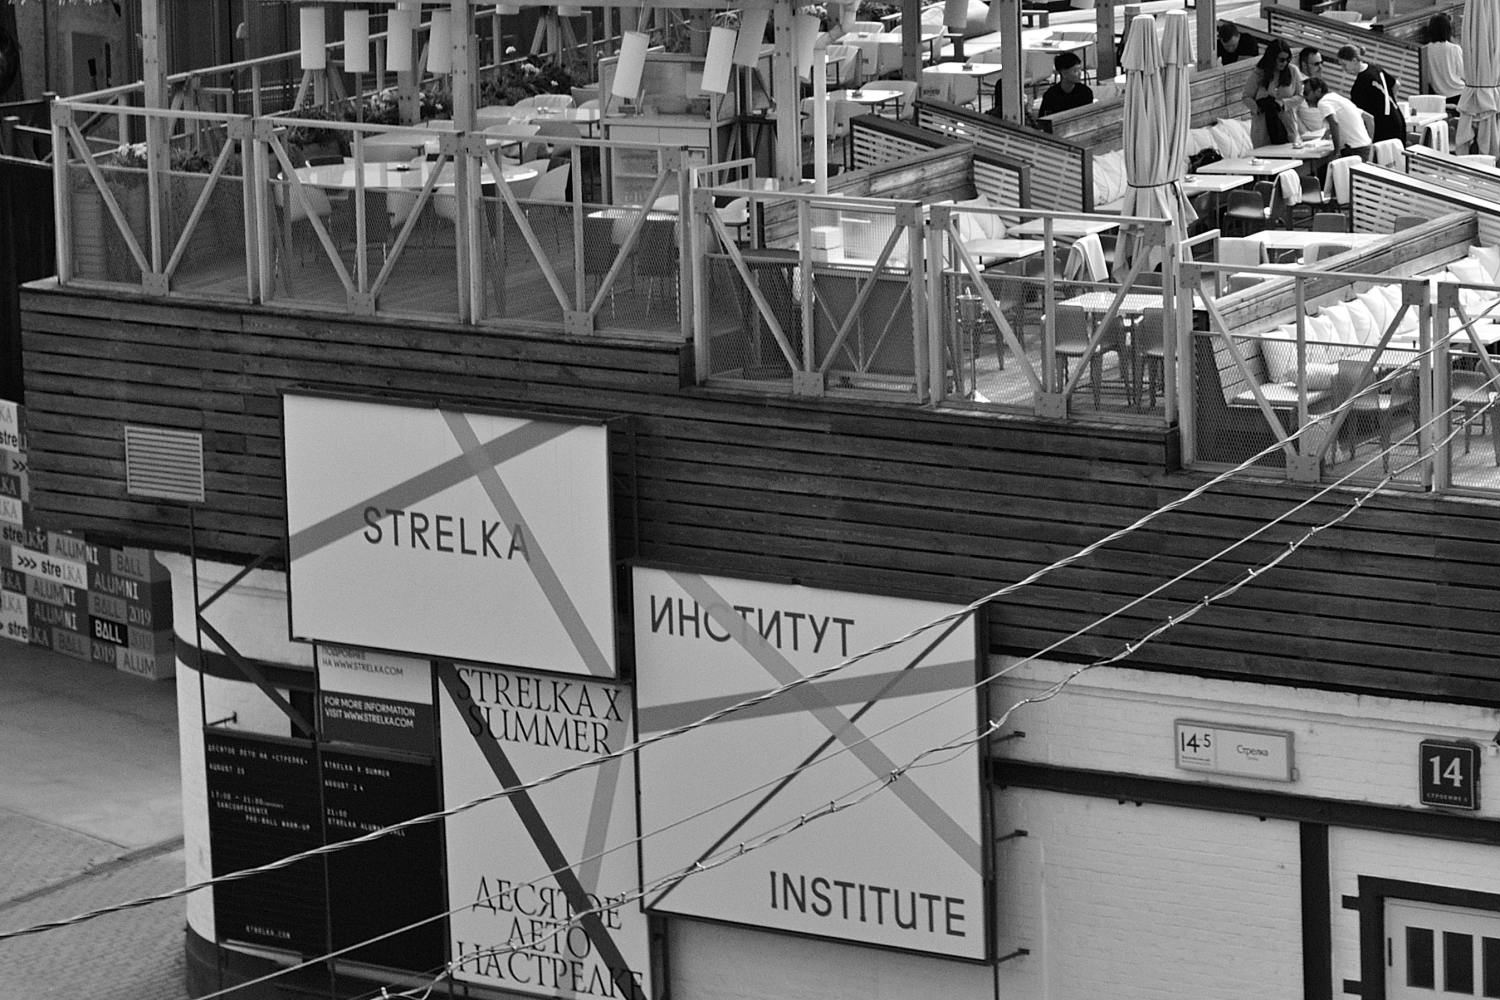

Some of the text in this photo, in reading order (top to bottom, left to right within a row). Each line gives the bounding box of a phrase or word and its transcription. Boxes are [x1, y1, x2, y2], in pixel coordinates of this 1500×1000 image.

[363, 506, 529, 561] STRELKA
[94, 571, 139, 600] ALUMNI
[95, 620, 122, 643] BALL
[651, 595, 855, 657] ИНСТИТУТ
[324, 696, 415, 717] FOR MORE INFORMATION
[457, 668, 623, 722] STRELKA X
[469, 704, 612, 755] SUMMER
[1429, 756, 1463, 787] 14
[770, 871, 965, 937] INSTITUTE
